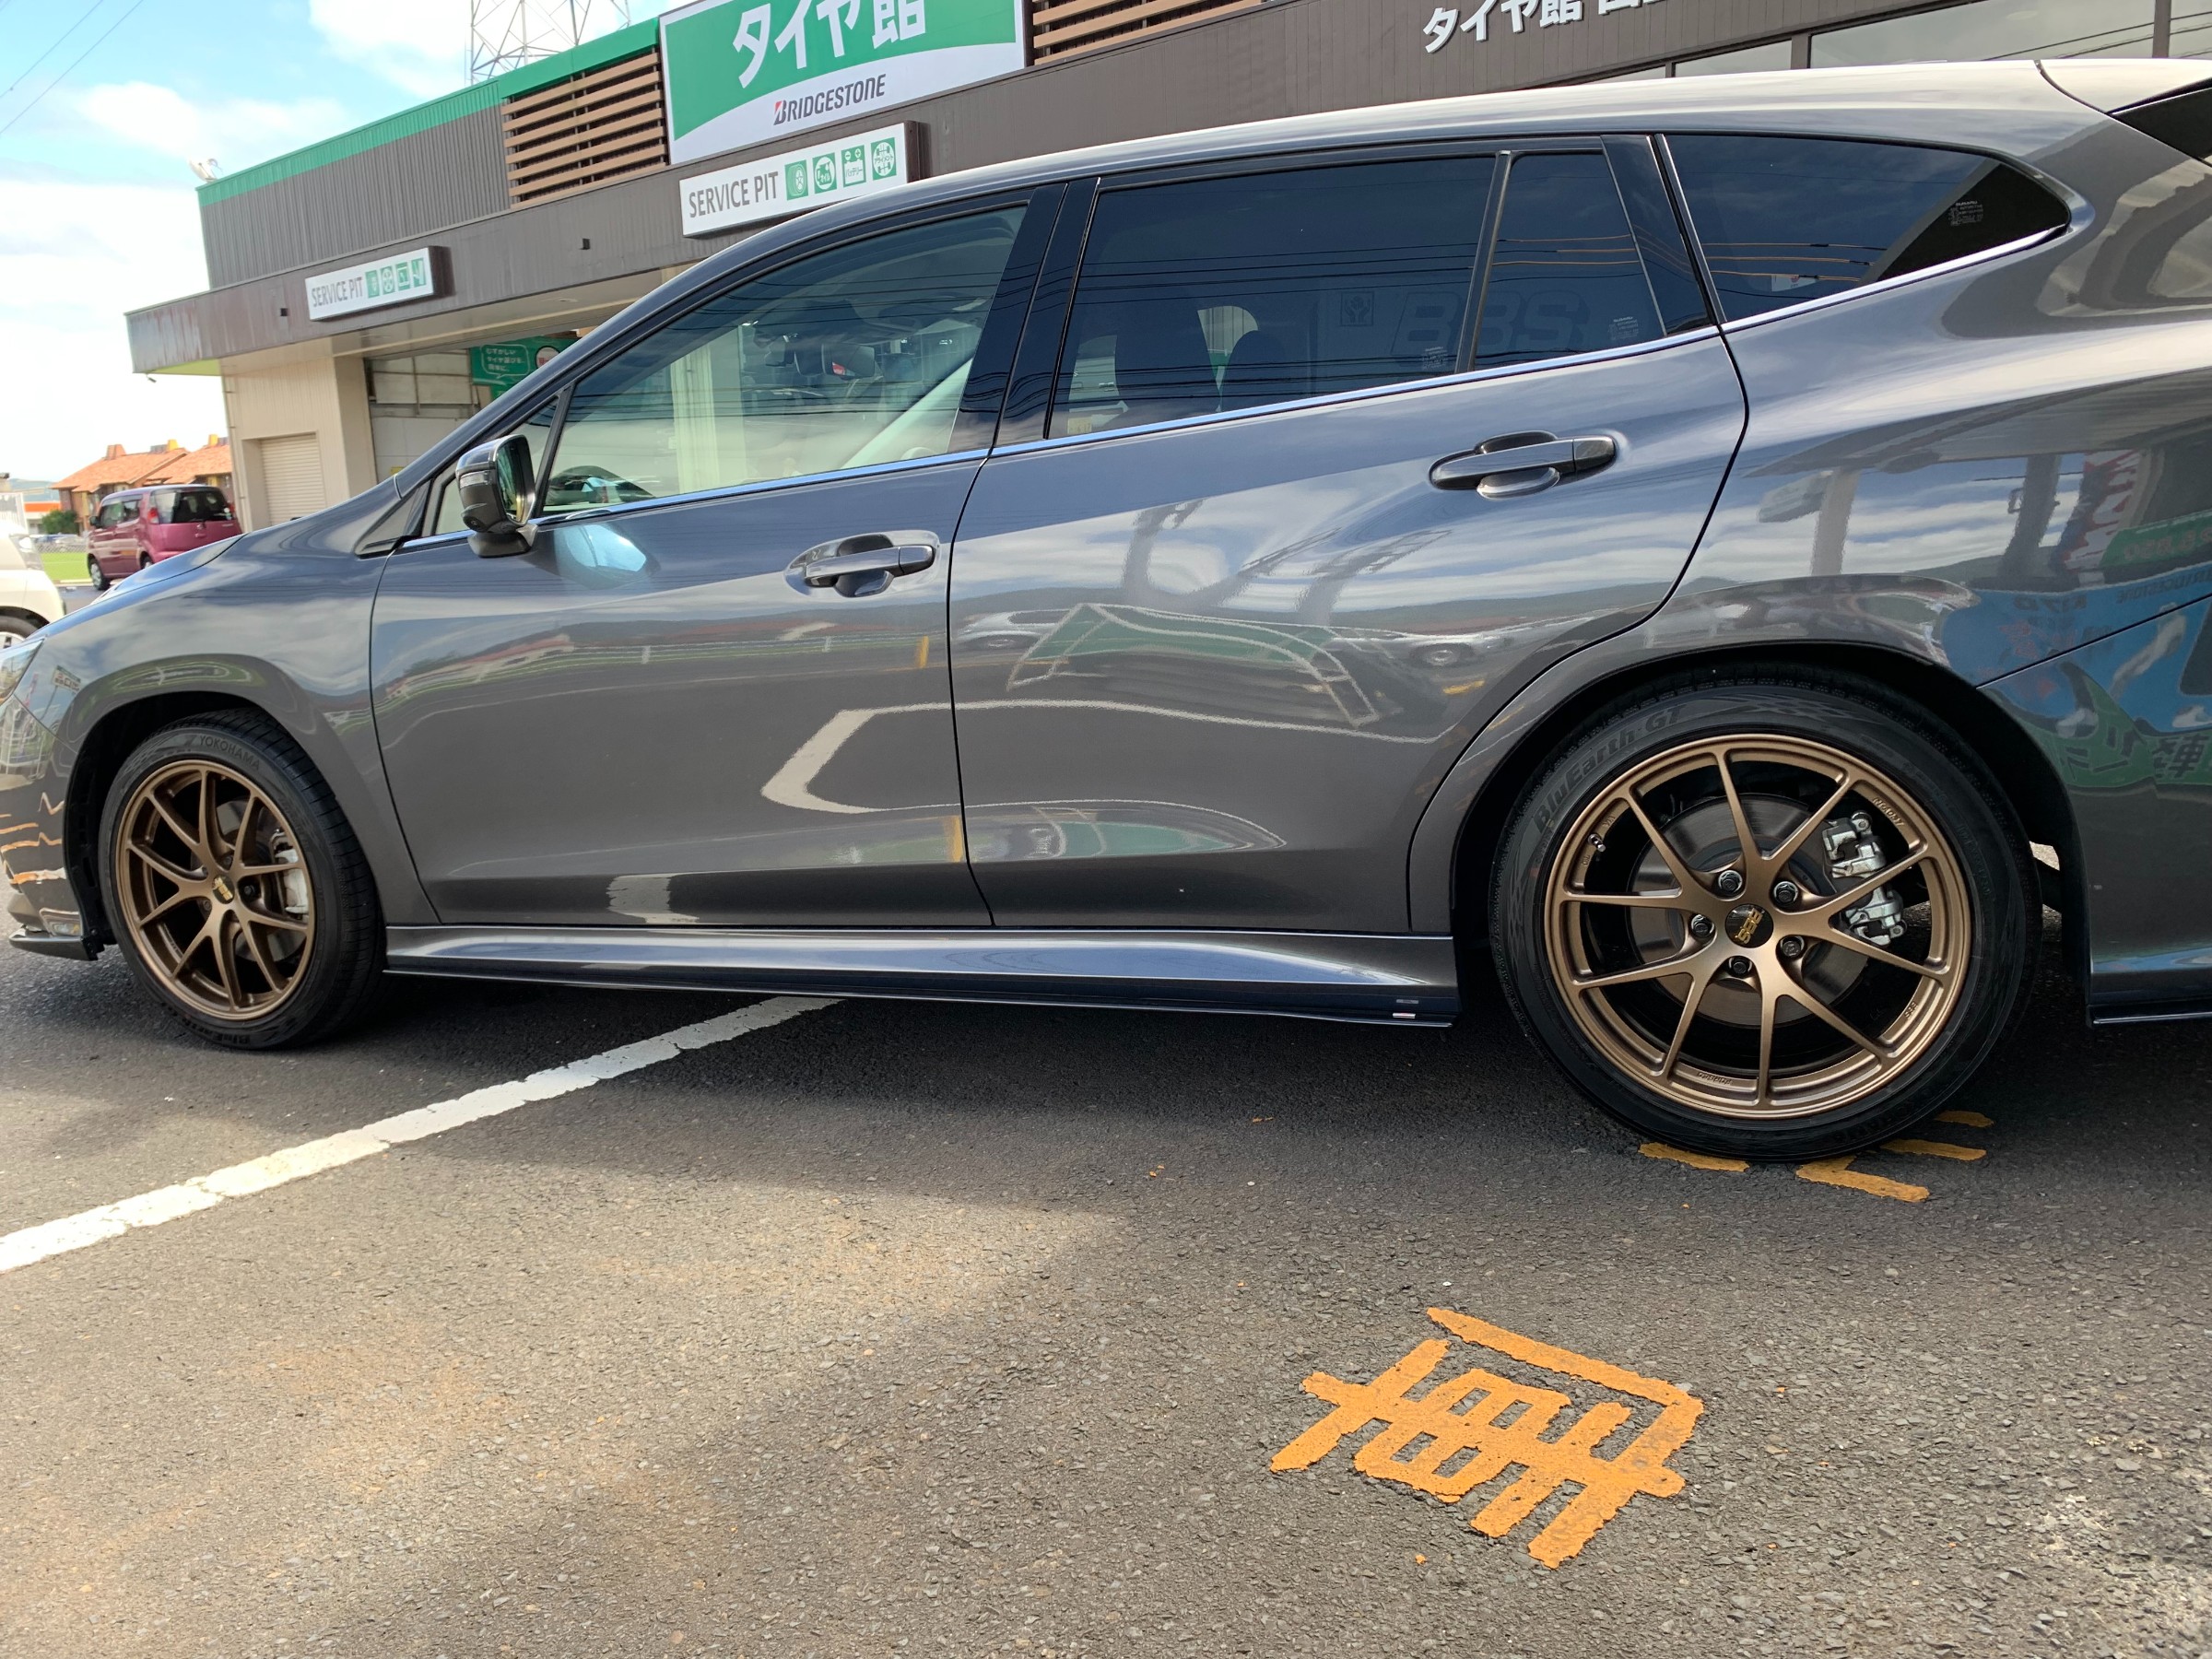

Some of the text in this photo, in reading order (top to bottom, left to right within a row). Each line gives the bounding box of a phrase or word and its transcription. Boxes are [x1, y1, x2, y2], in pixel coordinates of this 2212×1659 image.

[773, 73, 887, 126] BRIDGESTONE
[688, 171, 779, 218] SERVICE PIT
[312, 276, 363, 308] SERVICE PIT
[199, 735, 260, 771] YOKOHAMA
[1533, 704, 1687, 834] BluEarth-GT
[1736, 908, 1763, 945] BBS
